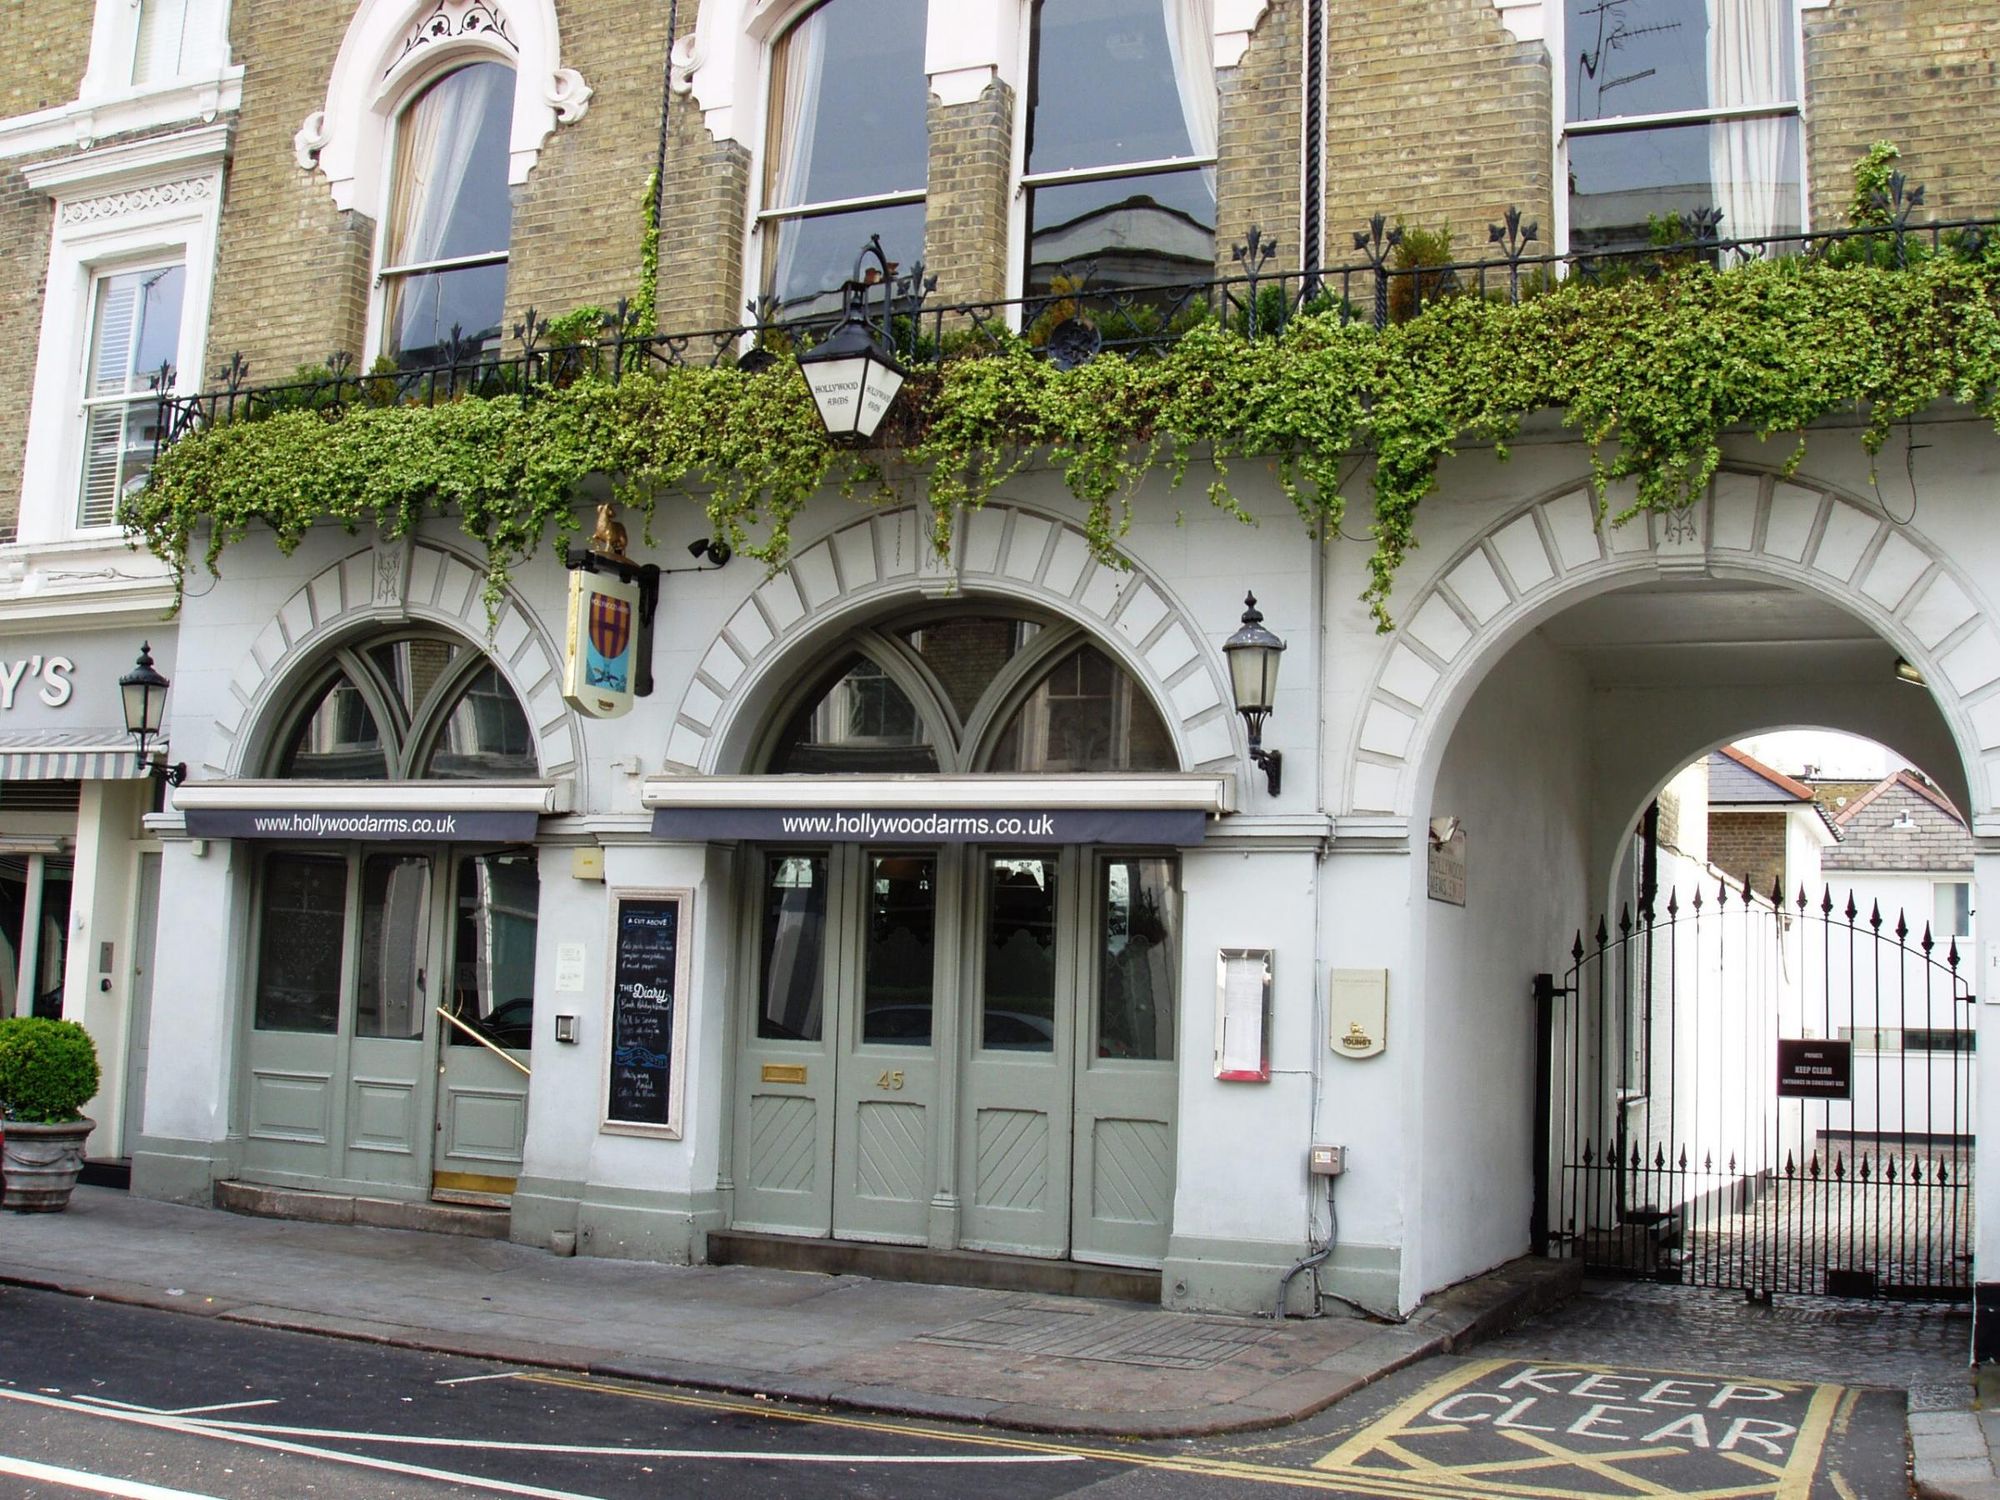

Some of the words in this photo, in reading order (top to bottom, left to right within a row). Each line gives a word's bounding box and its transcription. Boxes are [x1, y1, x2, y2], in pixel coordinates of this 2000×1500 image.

[815, 382, 858, 394] HOLLYWOOD
[0, 655, 75, 709] Y'S
[255, 814, 456, 835] www.hollywoodarms.co.uk
[782, 813, 1054, 838] www.hollywoodarms.co.uk
[620, 984, 633, 992] THE
[633, 983, 668, 1003] Diary
[877, 1070, 904, 1090] 45
[1794, 1065, 1811, 1074] KEEP
[1812, 1066, 1833, 1075] CLEAR
[1499, 1366, 1785, 1409] KEEP
[1427, 1393, 1797, 1455] CLEAR
